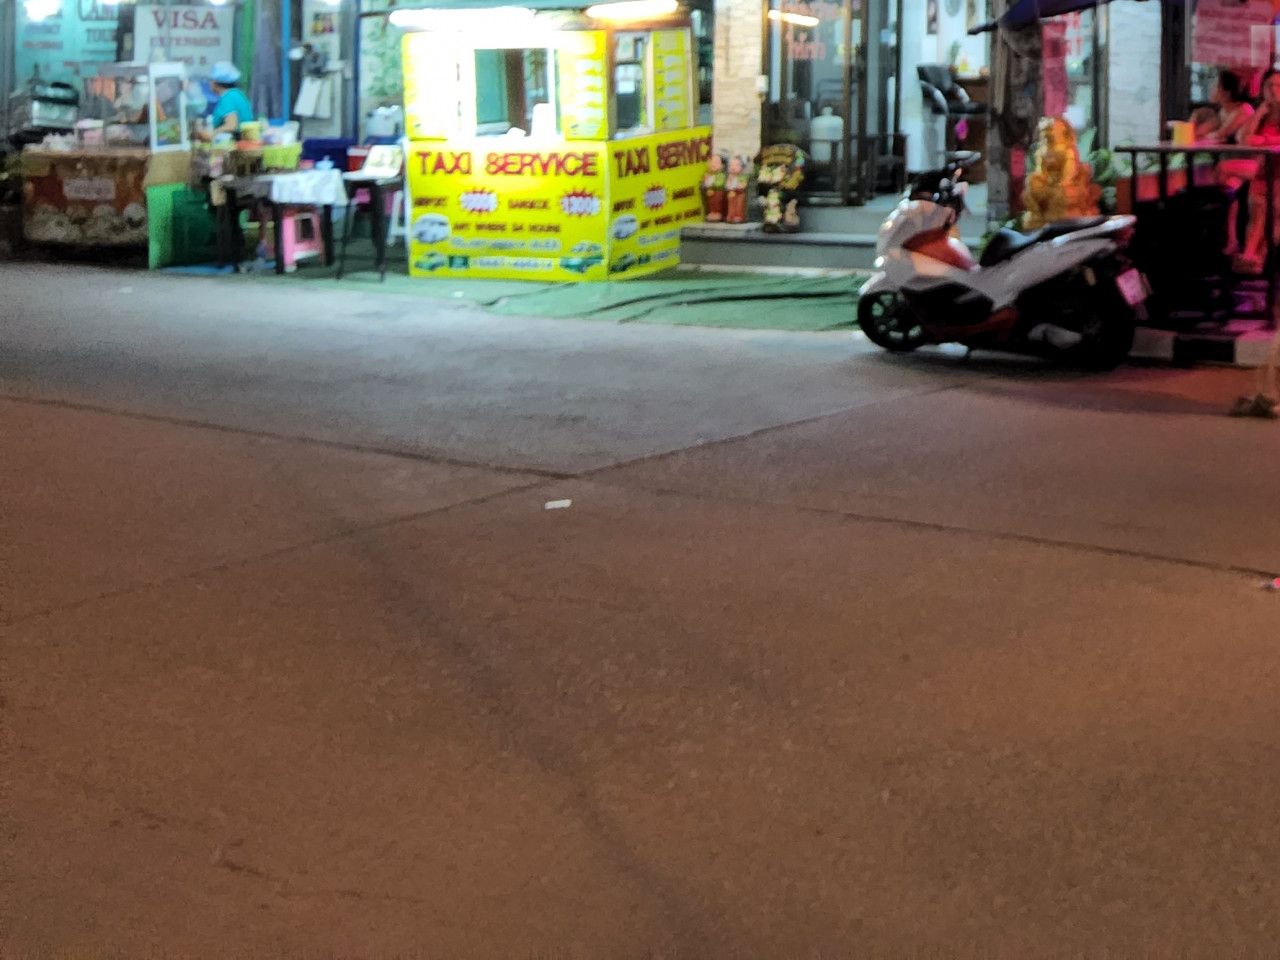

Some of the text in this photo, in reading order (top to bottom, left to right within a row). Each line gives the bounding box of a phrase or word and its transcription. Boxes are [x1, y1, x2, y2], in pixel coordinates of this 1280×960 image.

[151, 9, 219, 30] VISA
[417, 151, 599, 176] TAXI SERVICE
[614, 145, 650, 178] TAXI
